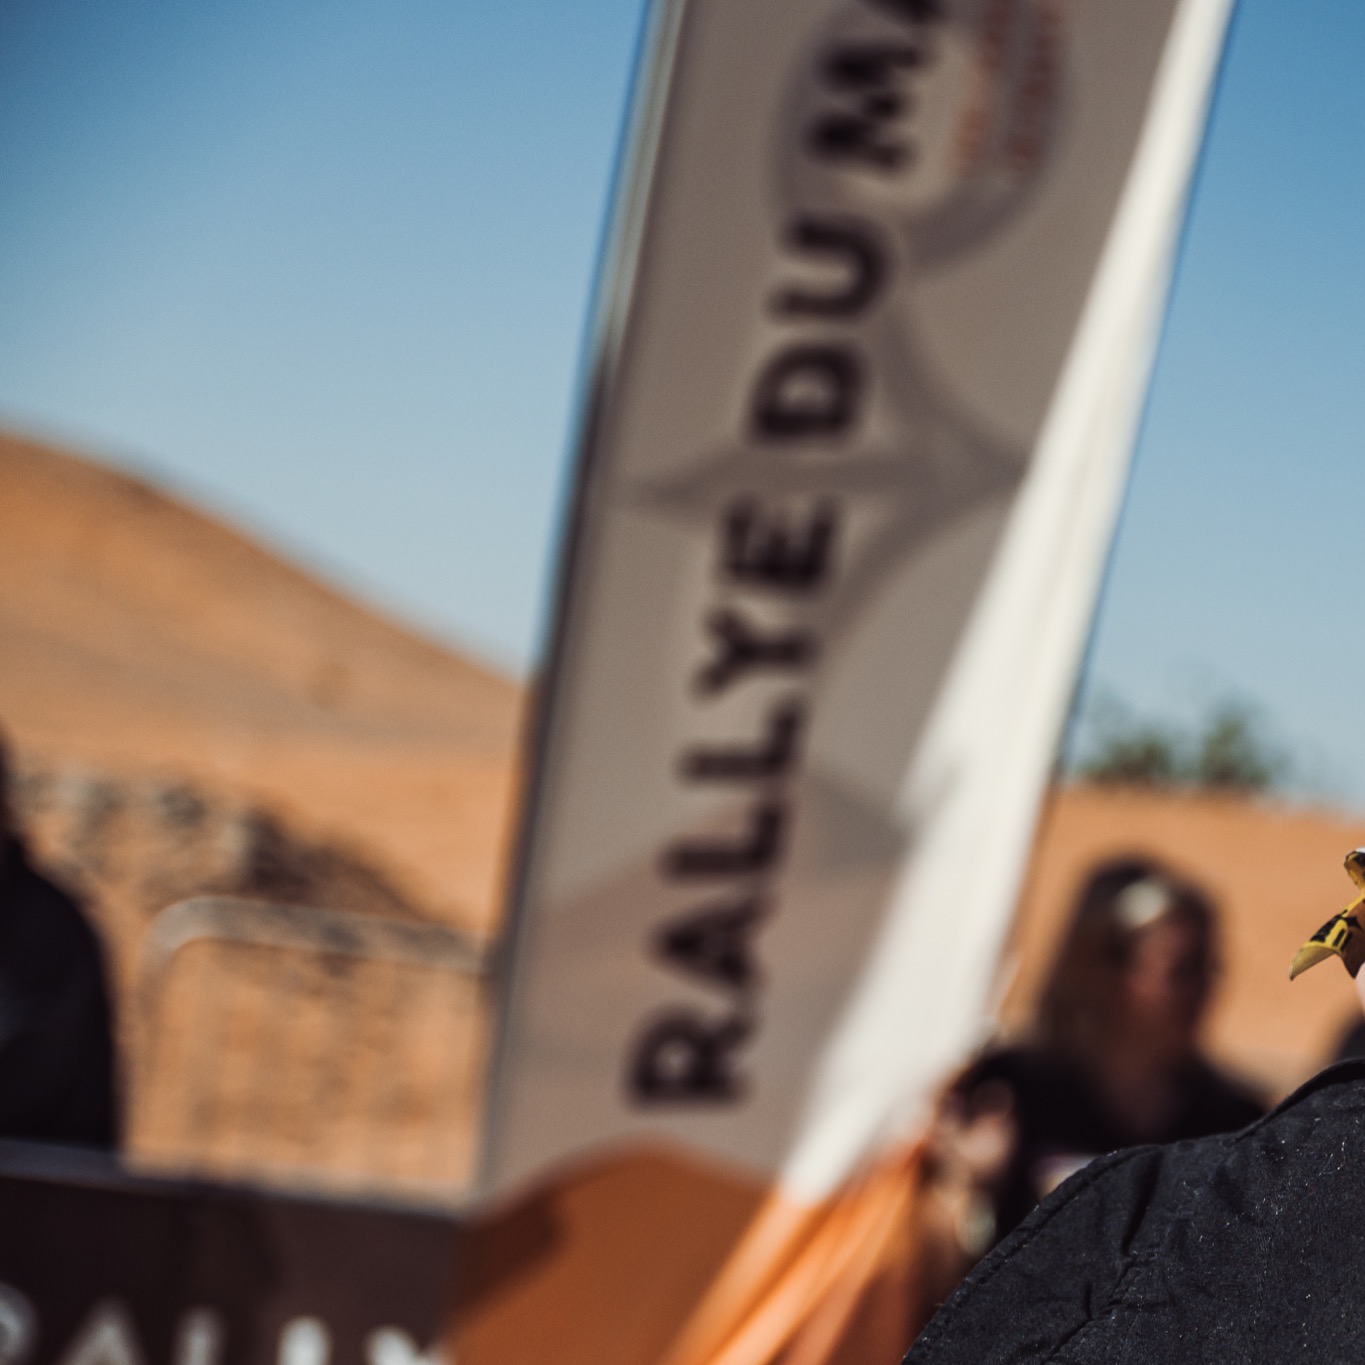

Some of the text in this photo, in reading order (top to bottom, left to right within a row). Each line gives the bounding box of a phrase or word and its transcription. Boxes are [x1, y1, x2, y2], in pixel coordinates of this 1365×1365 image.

[624, 0, 942, 1110] RALLYE DU M
